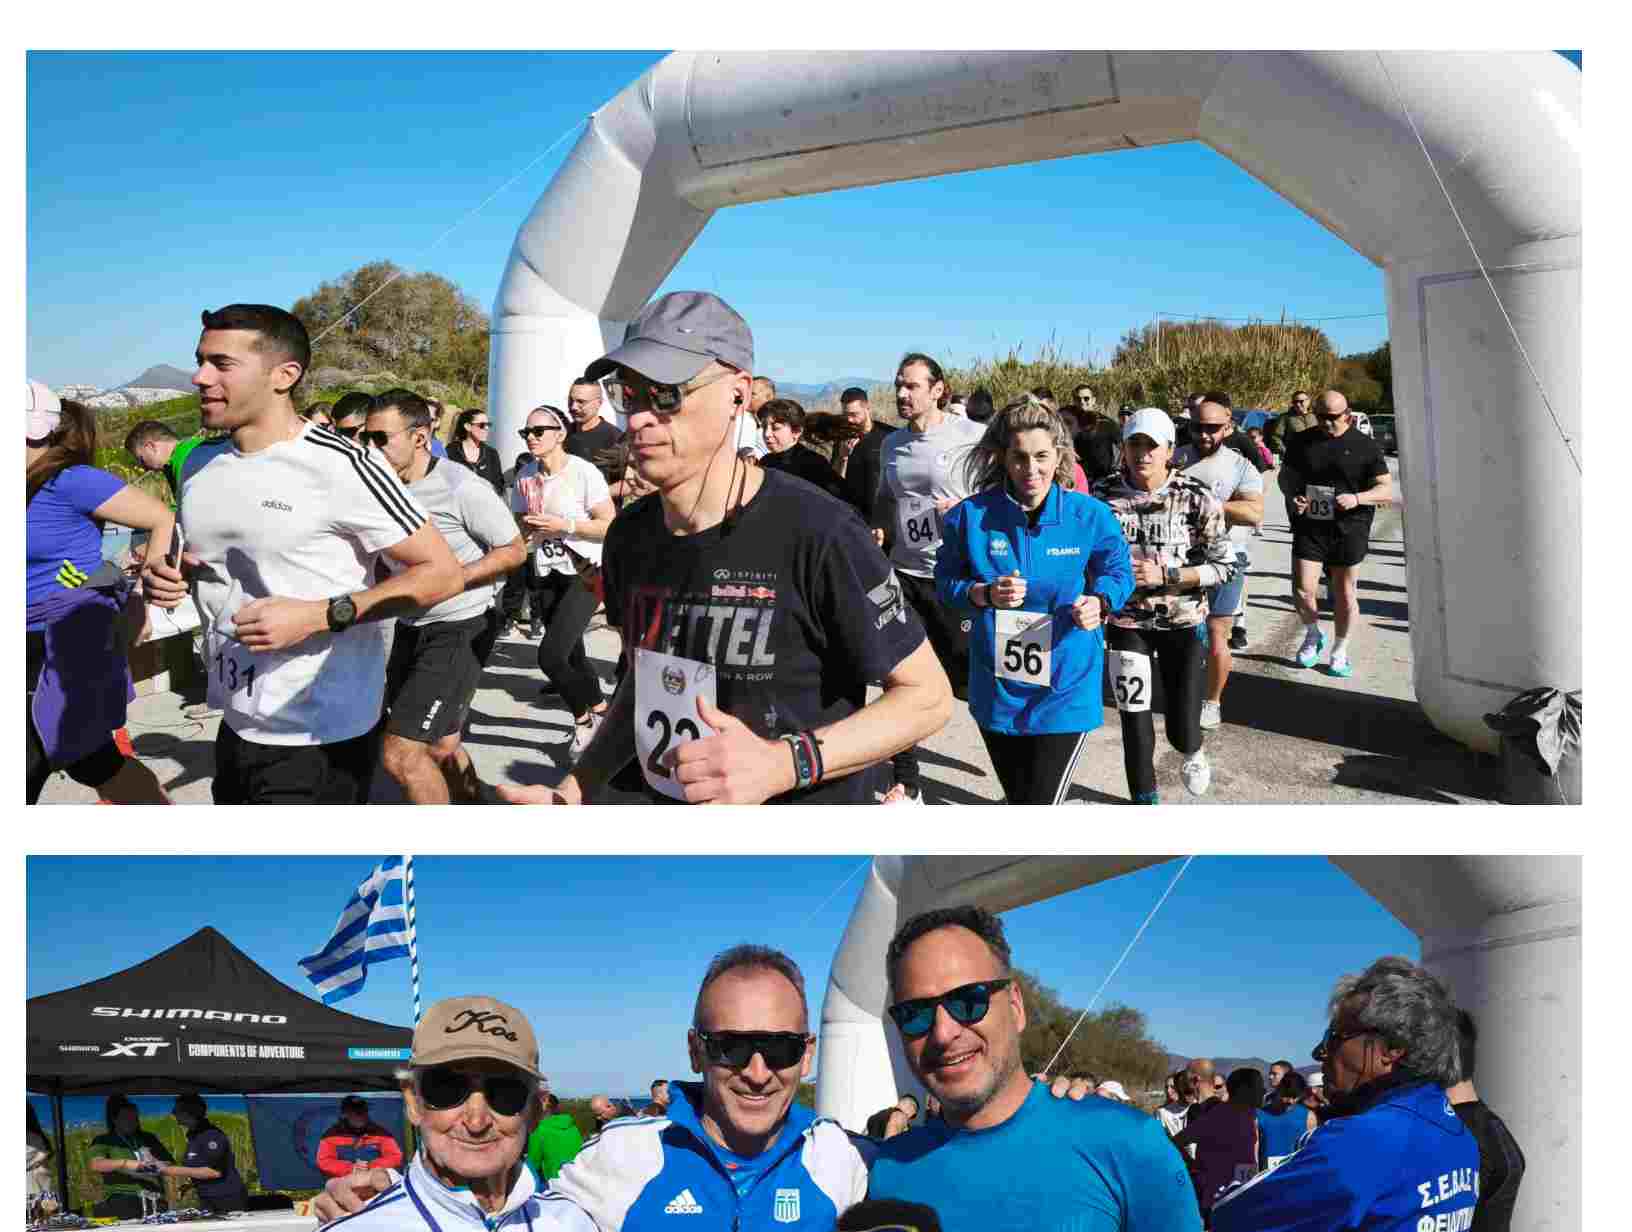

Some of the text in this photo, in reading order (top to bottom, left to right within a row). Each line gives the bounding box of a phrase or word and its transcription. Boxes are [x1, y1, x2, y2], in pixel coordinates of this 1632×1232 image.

[906, 518, 934, 543] 84
[1003, 639, 1043, 676] 56
[216, 652, 256, 698] 131
[1116, 676, 1144, 705] 52
[90, 1006, 288, 1025] SHIMANO
[99, 1042, 171, 1057] XT
[188, 1043, 246, 1058] COMPONENTS
[246, 1044, 257, 1058] OF
[259, 1045, 305, 1060] ADVENTURE
[664, 1204, 703, 1215] adidas
